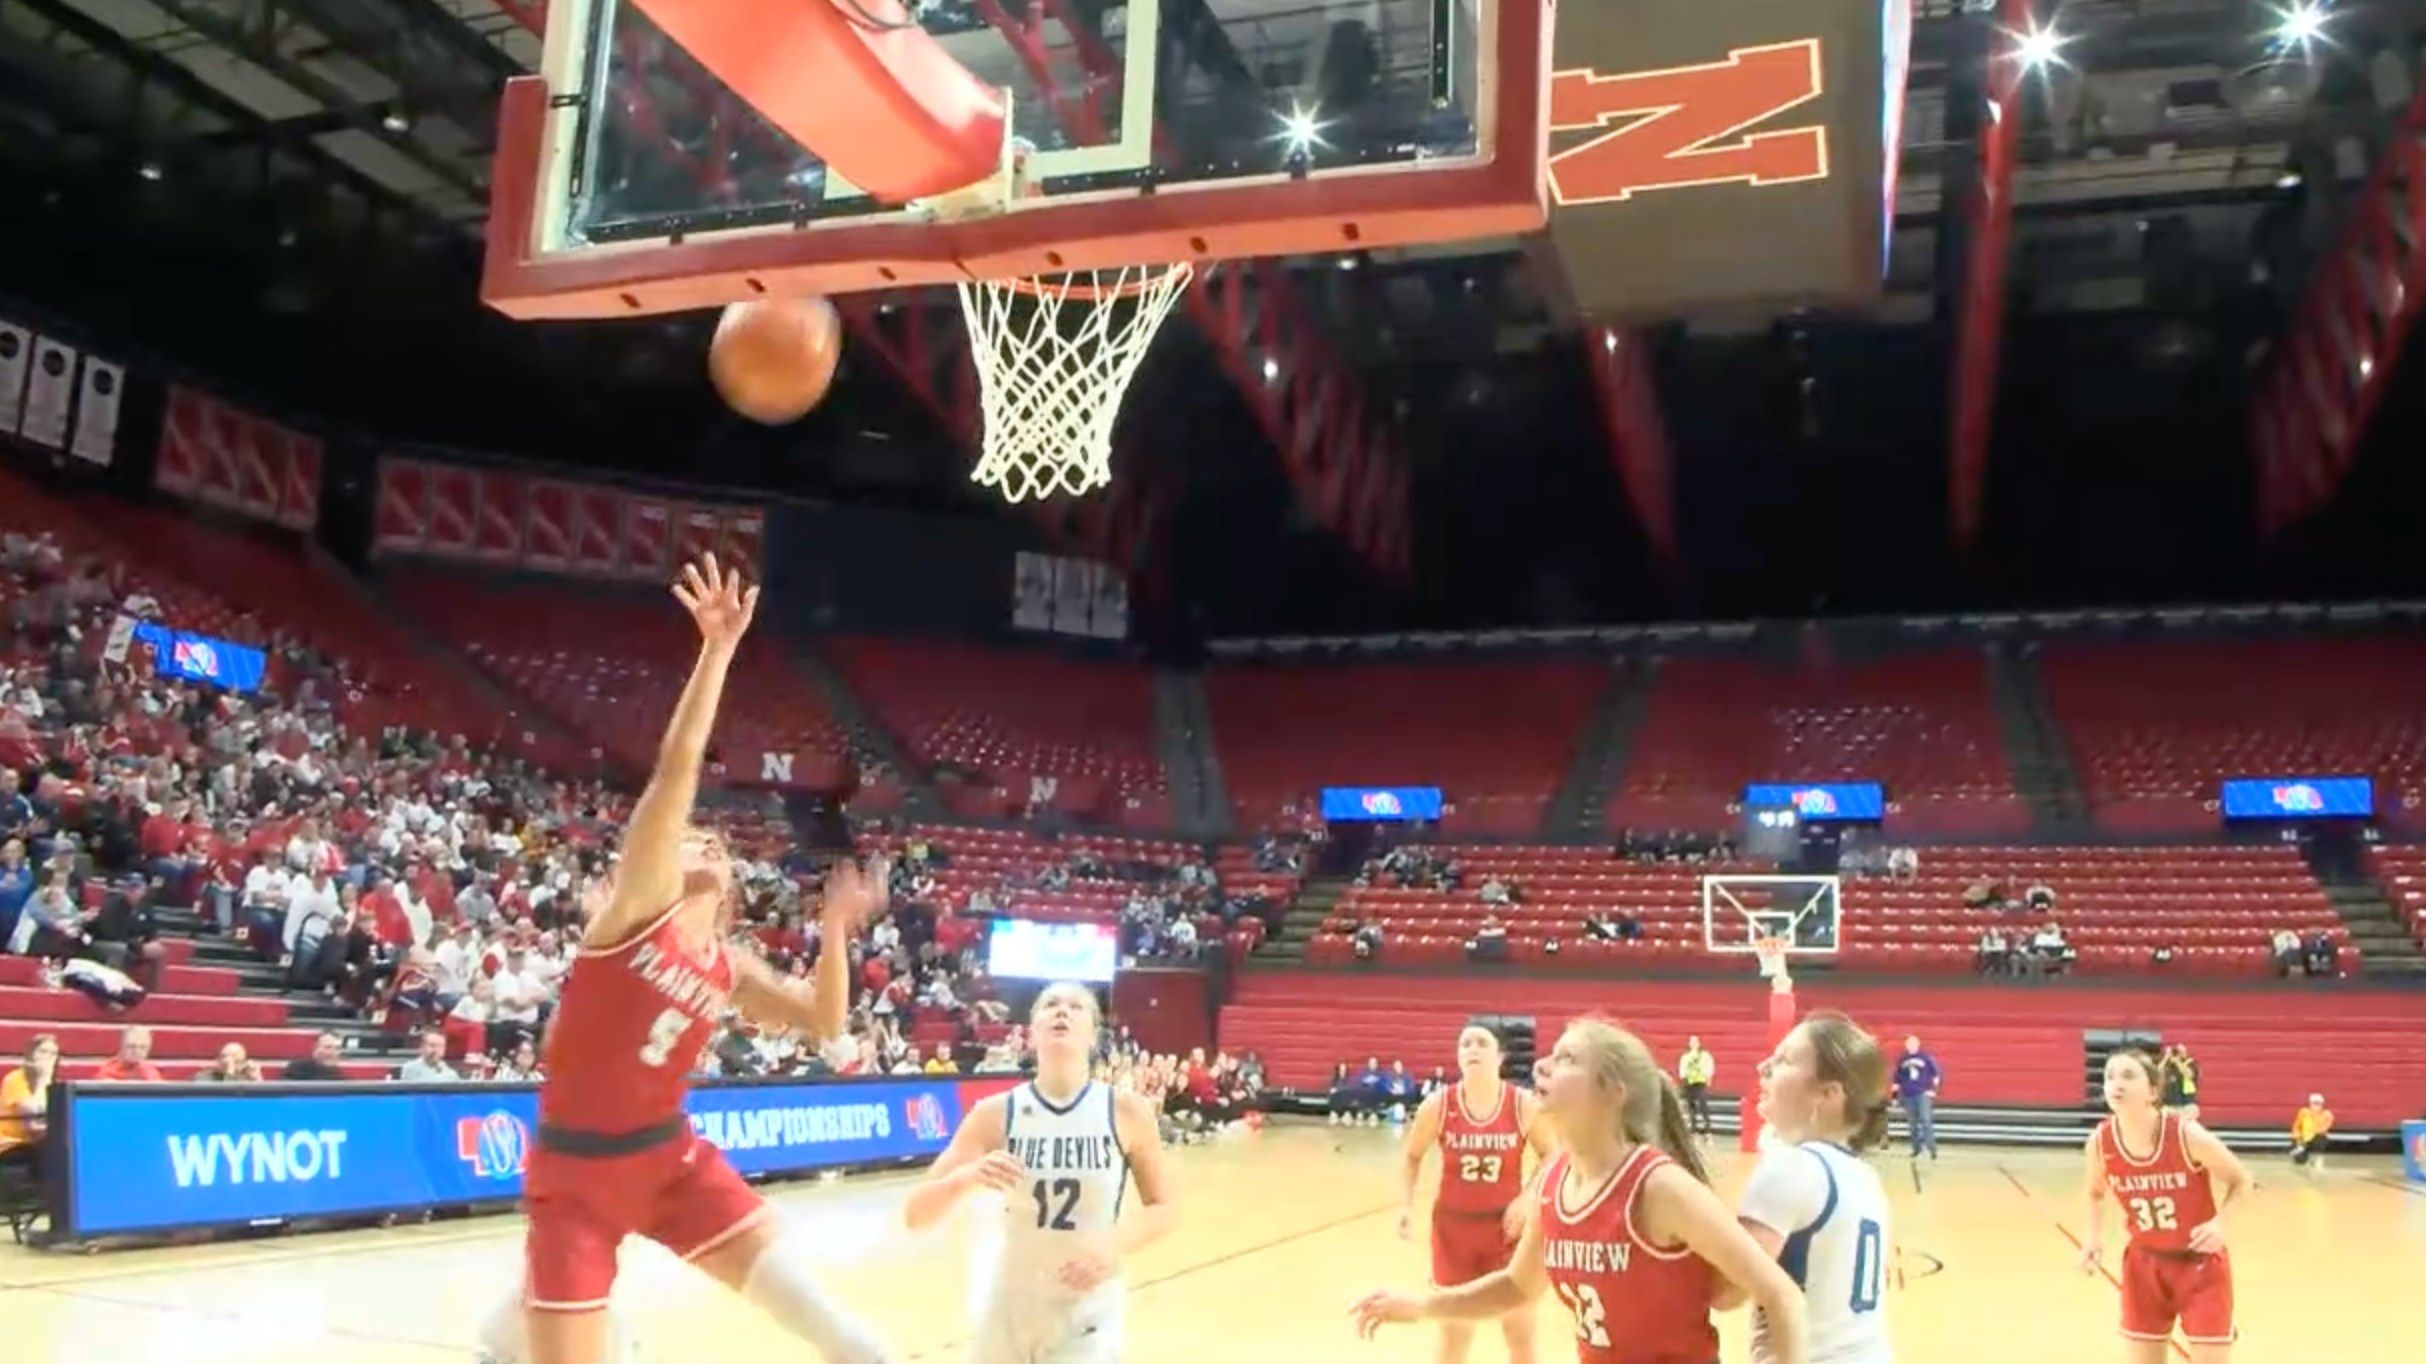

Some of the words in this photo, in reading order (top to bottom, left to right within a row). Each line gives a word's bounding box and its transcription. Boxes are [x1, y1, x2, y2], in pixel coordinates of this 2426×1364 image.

[761, 752, 795, 782] N
[1030, 776, 1058, 802] N
[689, 1103, 892, 1151] CHAMPIONSHIPS
[1445, 1131, 1518, 1150] PLAINVIEW
[168, 1130, 347, 1187] WYNOT
[1053, 1135, 1112, 1169] DEVILS
[1460, 1154, 1502, 1183] 23
[2106, 1171, 2187, 1193] PLAINVIEW
[1032, 1178, 1081, 1230] 12
[2129, 1196, 2178, 1232] 32
[1849, 1217, 1880, 1314] 0
